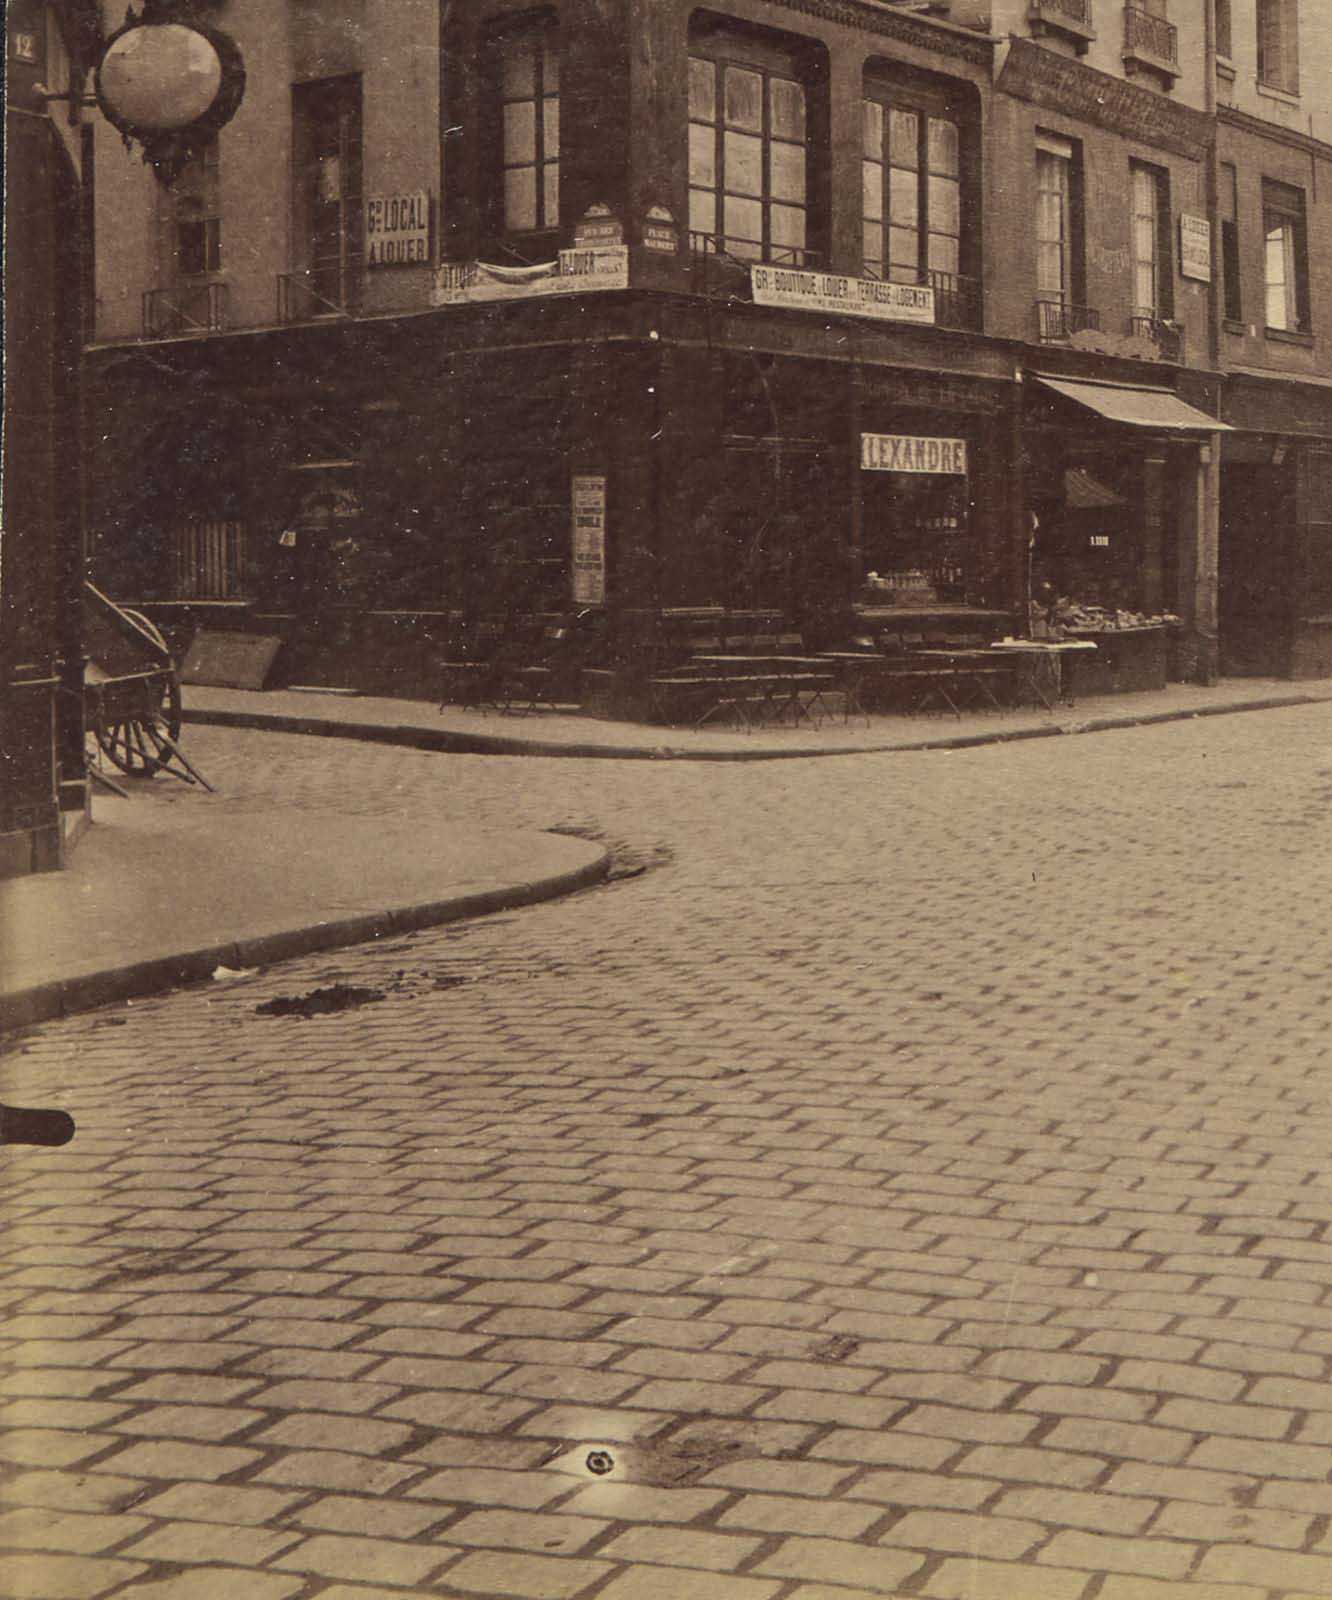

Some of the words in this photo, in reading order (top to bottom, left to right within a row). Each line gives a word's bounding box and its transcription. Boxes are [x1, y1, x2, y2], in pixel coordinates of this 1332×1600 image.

[384, 198, 425, 232] LOCAL
[369, 241, 378, 264] A
[380, 239, 425, 264] LOUER
[775, 271, 817, 296] BOUTIQUE
[822, 277, 849, 299] LOUER
[857, 281, 891, 305] TERRASSE
[896, 288, 931, 310] LOGEMENT
